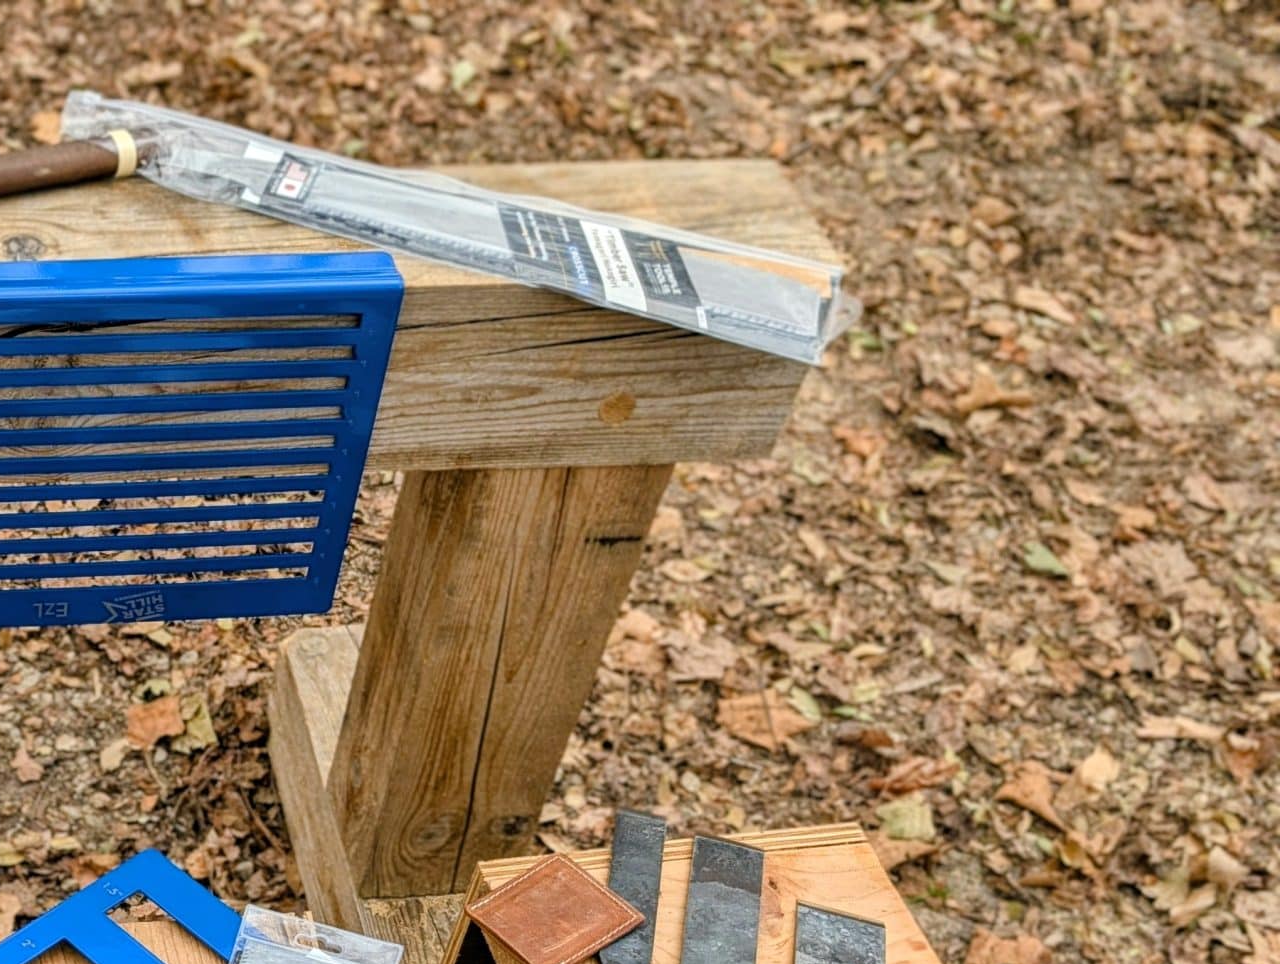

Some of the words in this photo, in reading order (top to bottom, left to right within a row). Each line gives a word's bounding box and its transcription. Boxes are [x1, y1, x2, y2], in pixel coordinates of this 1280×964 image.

[125, 594, 164, 607] HILL
[32, 602, 69, 619] EzL
[122, 604, 166, 619] STAR
